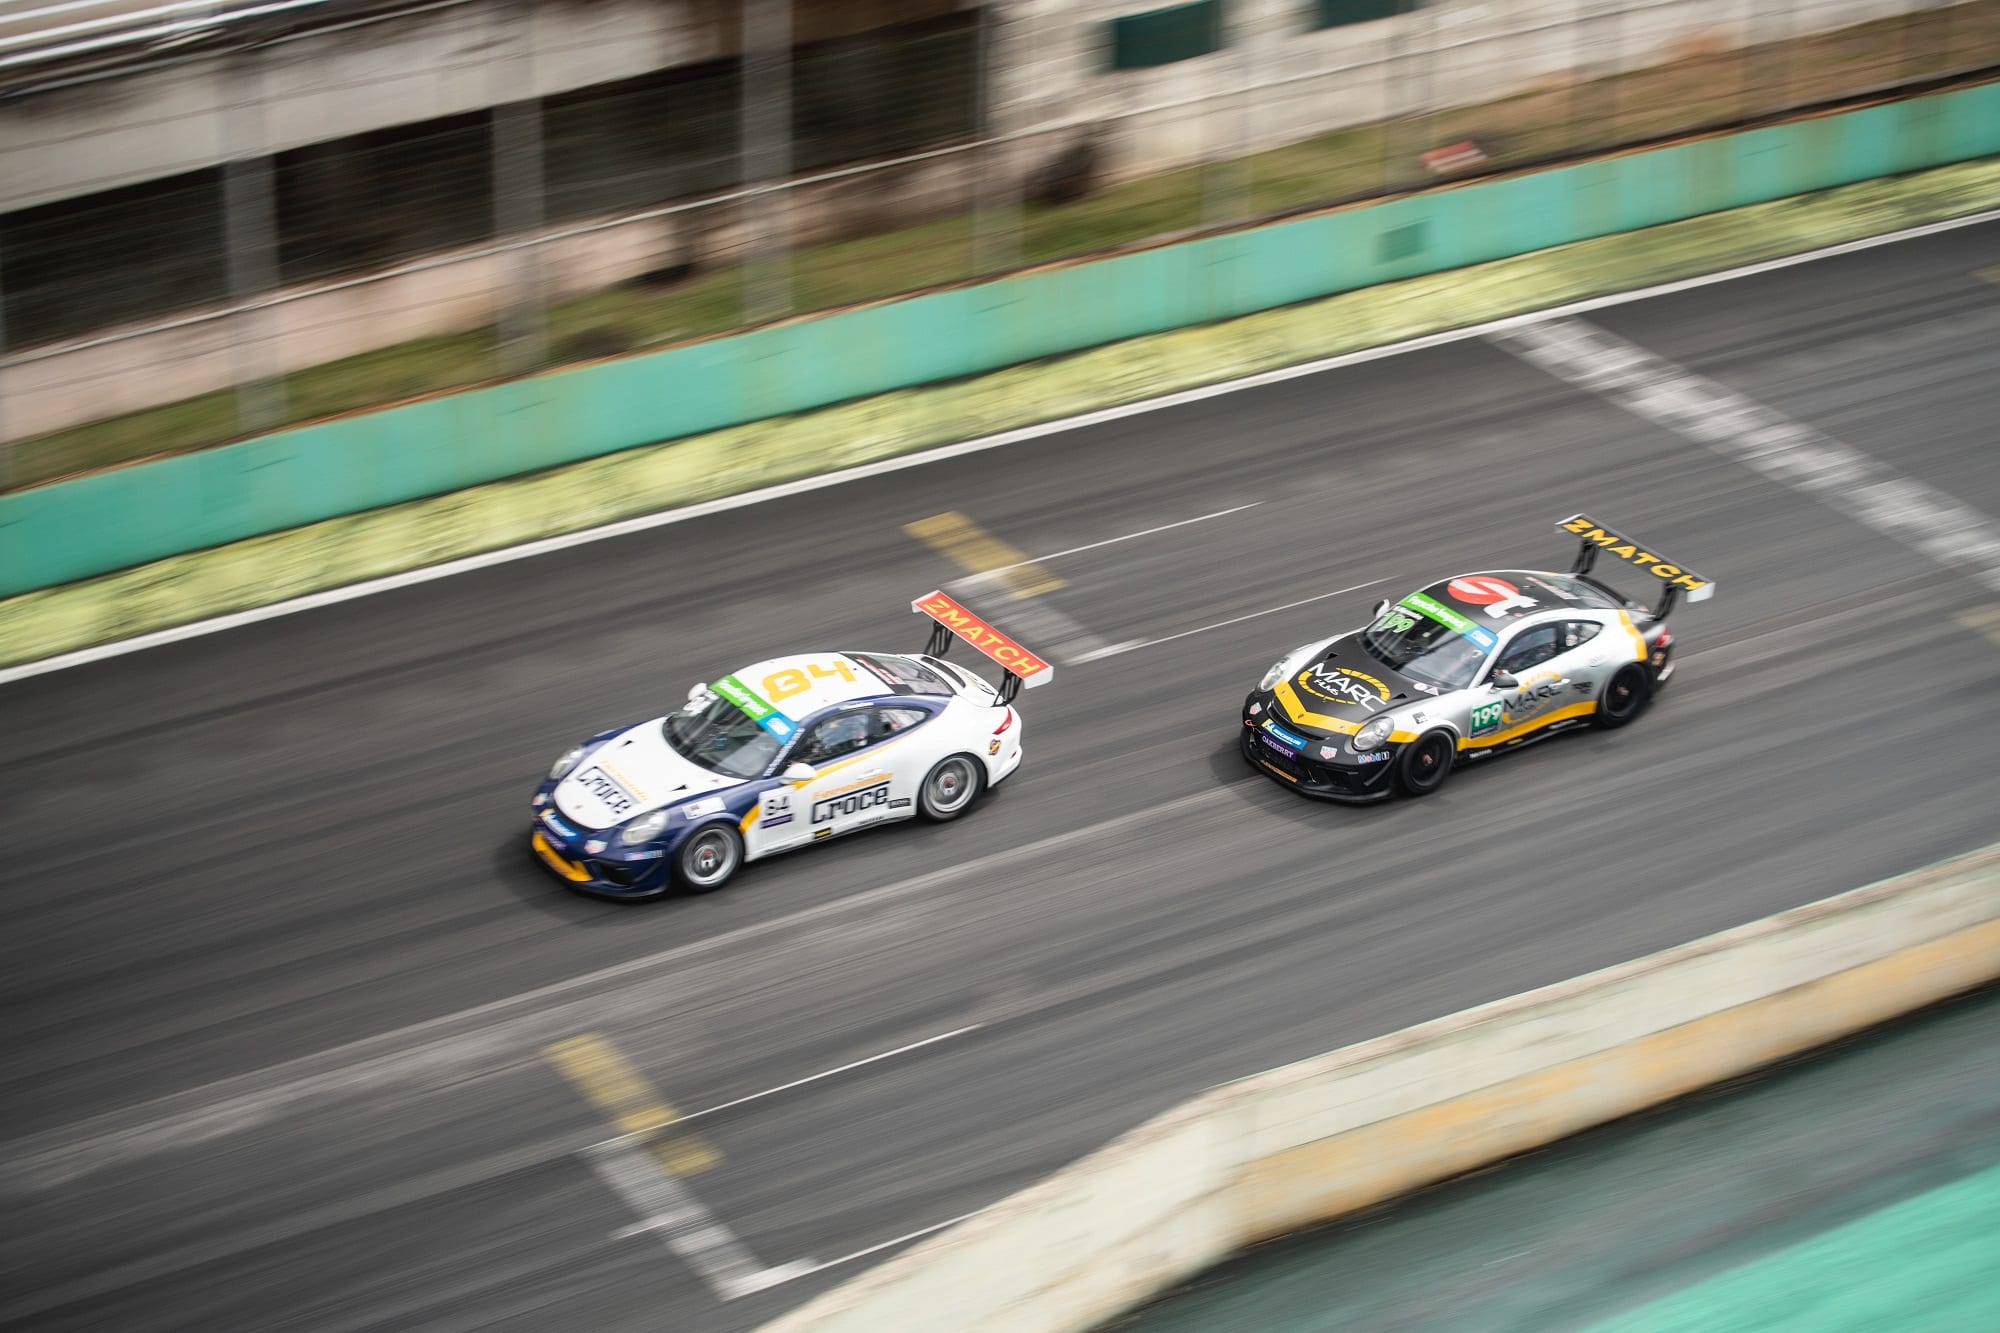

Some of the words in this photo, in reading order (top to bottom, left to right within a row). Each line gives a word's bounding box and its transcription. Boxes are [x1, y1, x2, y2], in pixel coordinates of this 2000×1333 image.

[1563, 519, 1707, 591] ZMATCH
[923, 598, 1040, 674] ZMATCH
[1371, 610, 1416, 634] 199
[762, 661, 857, 703] 84
[1307, 662, 1388, 712] MARC
[1472, 703, 1501, 727] 199
[1261, 735, 1294, 758] OAKBERRY
[764, 796, 790, 816] 84
[810, 780, 890, 824] Croce
